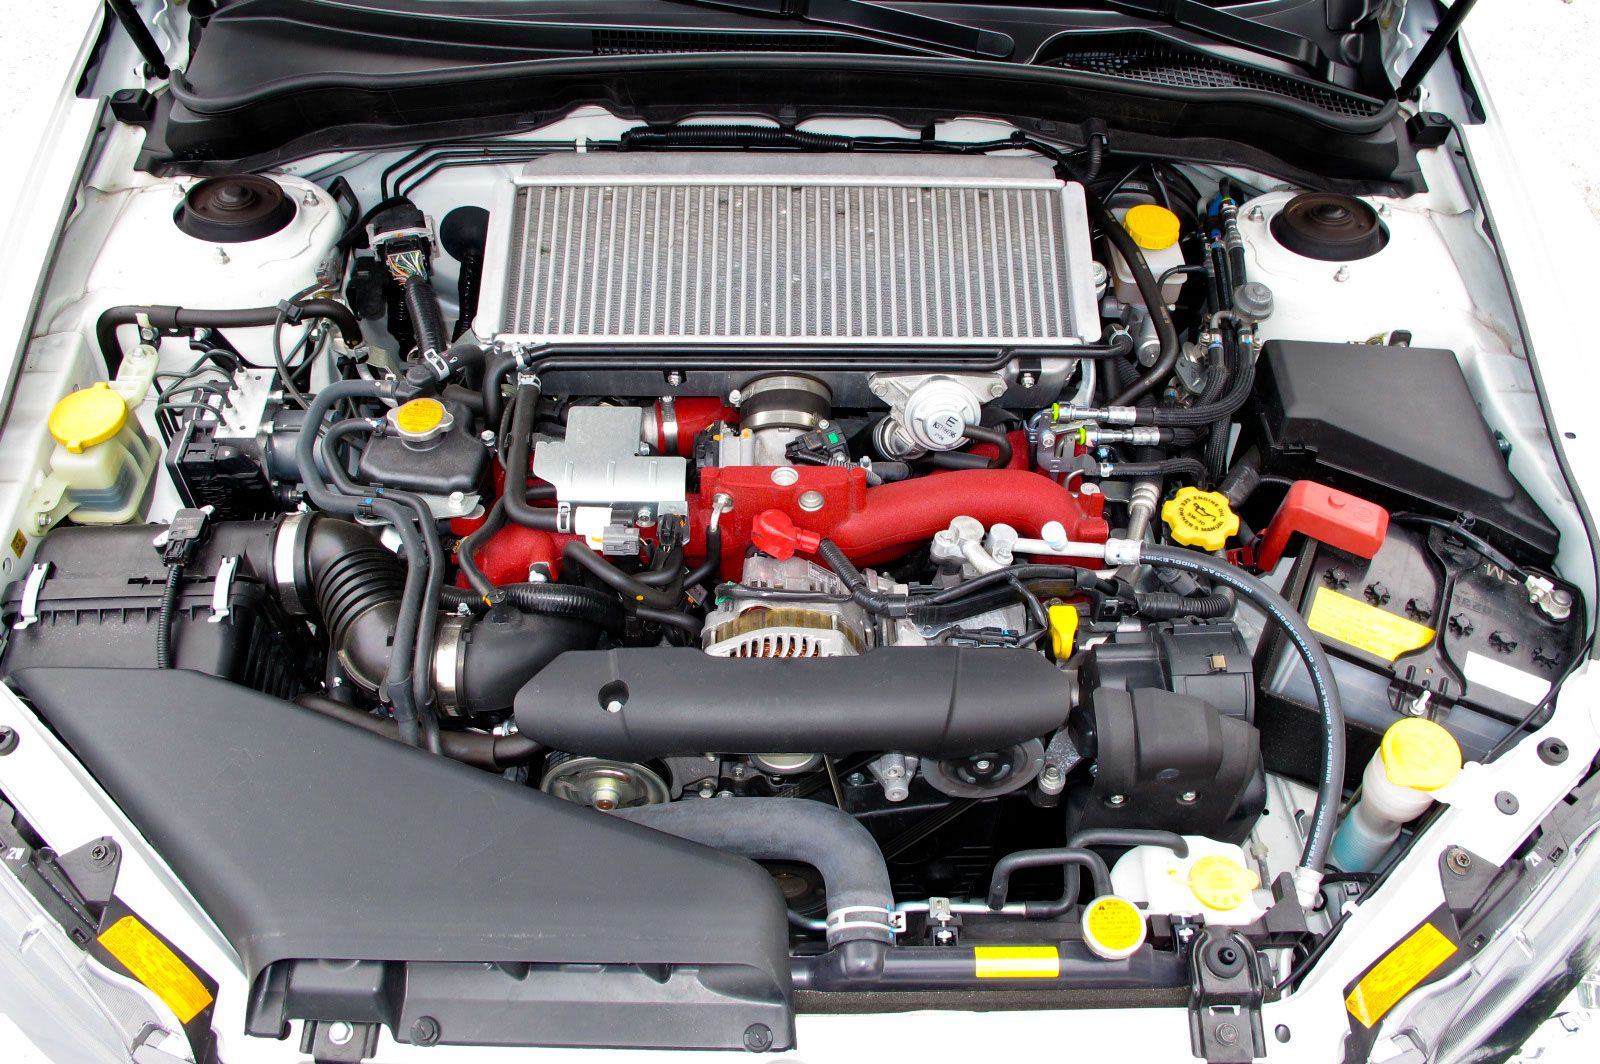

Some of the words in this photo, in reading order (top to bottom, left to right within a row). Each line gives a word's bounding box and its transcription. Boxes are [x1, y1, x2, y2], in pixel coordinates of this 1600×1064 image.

[945, 416, 958, 428] E
[1193, 496, 1219, 508] ENGINE
[1200, 520, 1225, 532] MANUAL
[1305, 804, 1327, 869] UTER>EPDM<
